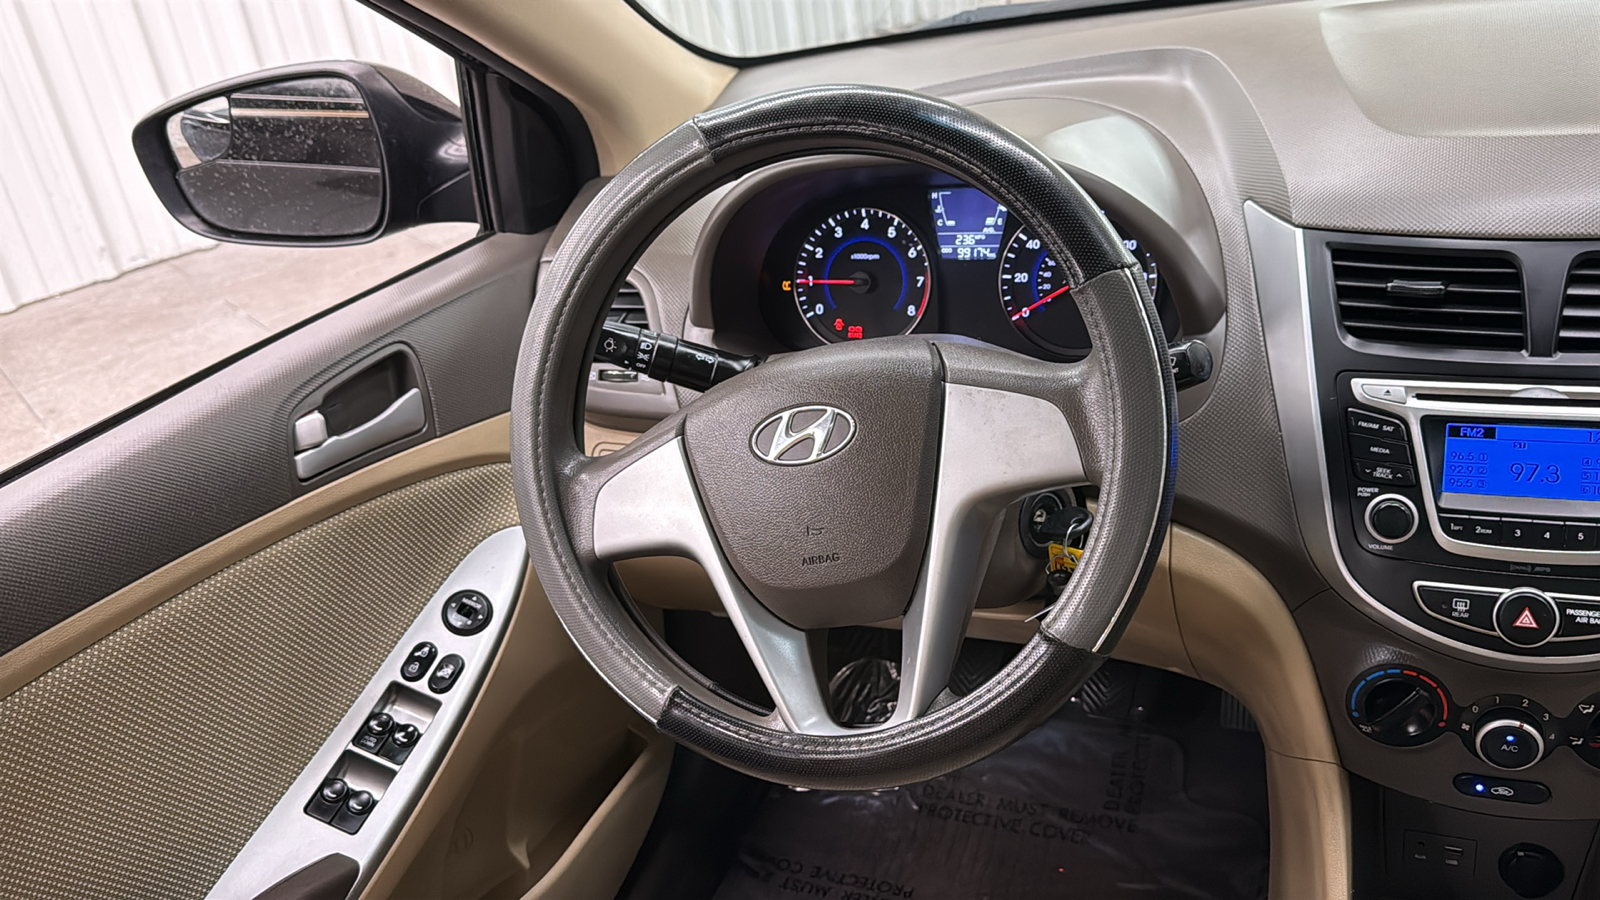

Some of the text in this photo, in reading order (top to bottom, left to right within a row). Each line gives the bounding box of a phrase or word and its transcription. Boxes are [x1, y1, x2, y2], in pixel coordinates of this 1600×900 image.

[860, 218, 870, 230] 4
[834, 226, 843, 238] 3
[887, 226, 897, 238] 5
[955, 234, 975, 246] 236
[1025, 239, 1040, 250] 40
[814, 247, 824, 259] 2
[907, 246, 917, 258] 6
[957, 247, 990, 259] 99174
[916, 276, 925, 288] 7
[1014, 272, 1029, 283] 20
[815, 303, 824, 315] 0
[906, 304, 916, 317] 8
[1021, 307, 1030, 318] 0
[1358, 421, 1380, 430] FM/AM
[1460, 427, 1485, 438] FM2
[1370, 446, 1390, 454] MEDIA
[1450, 451, 1474, 462] 96.5
[1449, 464, 1474, 475] 92.9
[1510, 463, 1560, 484] 97.3
[1448, 477, 1473, 488] 95.5
[1514, 529, 1521, 537] 3
[1544, 531, 1550, 539] 4
[1577, 532, 1584, 540] 5
[802, 553, 840, 566] AIRBAG
[1495, 696, 1500, 704] 1
[1522, 699, 1529, 707] 2
[1472, 705, 1479, 713] 0
[1542, 713, 1549, 721] 3
[1501, 745, 1518, 753] A/C
[922, 783, 986, 808] DEALER
[778, 877, 833, 898] MUST
